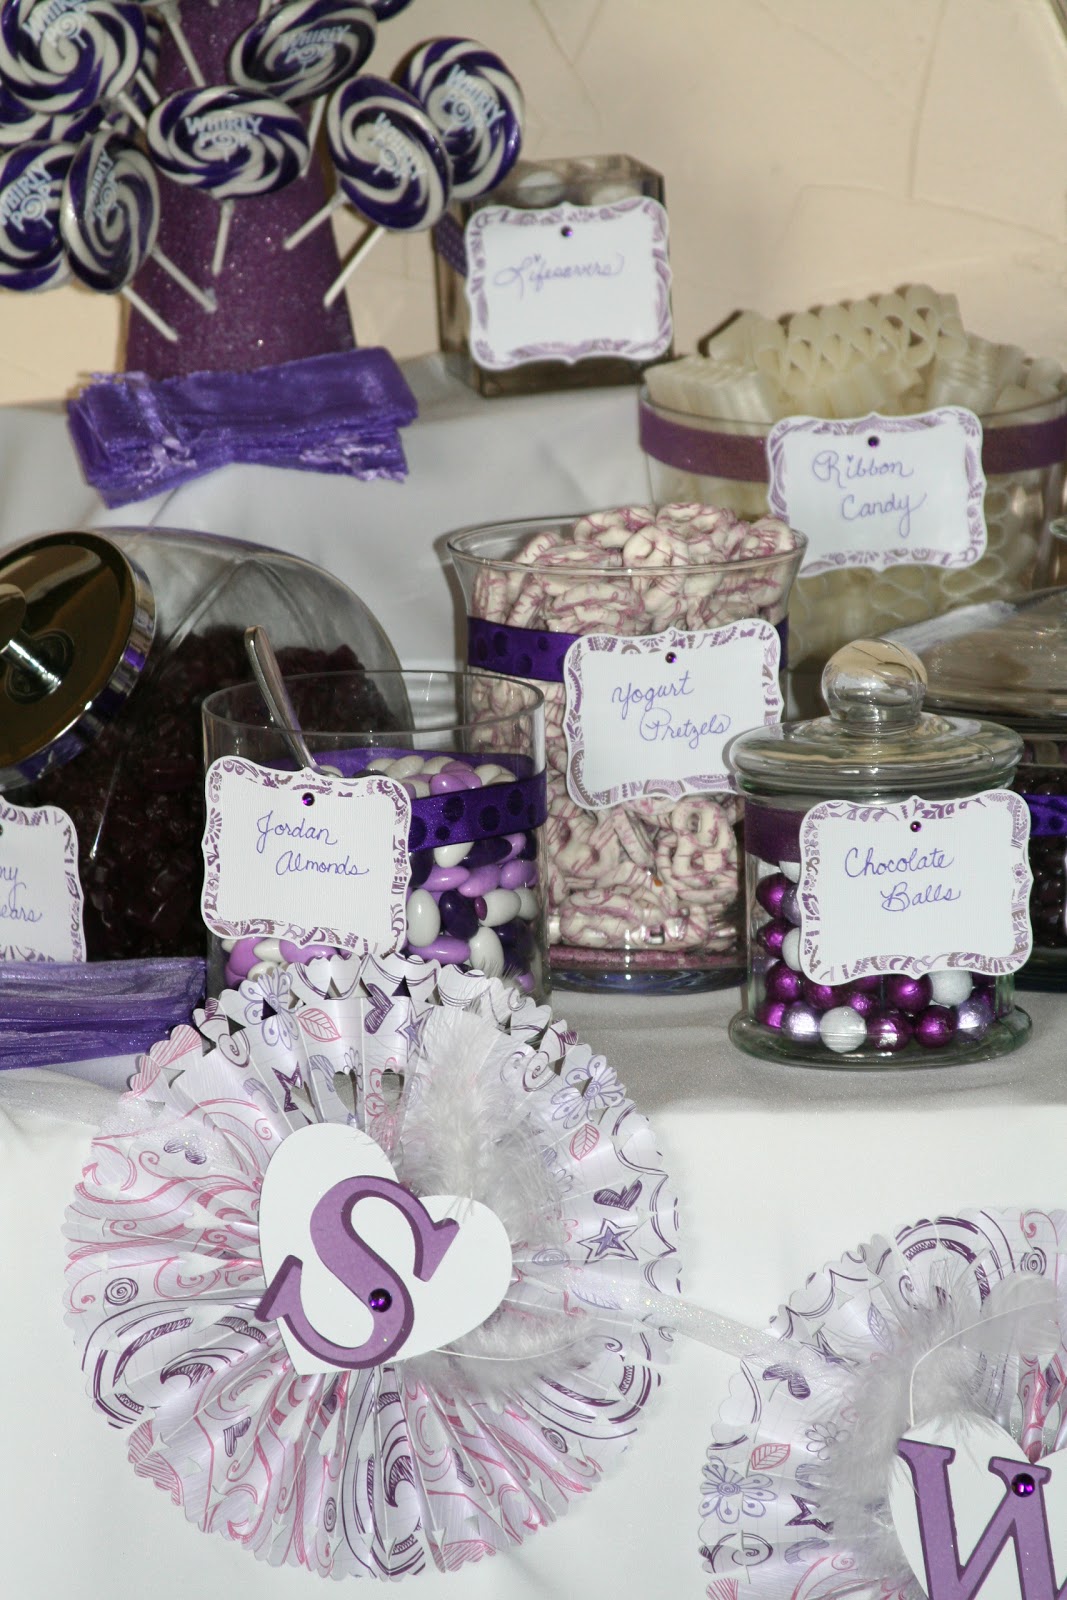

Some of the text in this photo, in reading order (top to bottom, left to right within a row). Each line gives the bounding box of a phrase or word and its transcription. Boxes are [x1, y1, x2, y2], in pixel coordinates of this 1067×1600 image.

[812, 450, 914, 488] Ribbon
[841, 492, 927, 538] Candy
[611, 670, 695, 720] Yogurt
[639, 706, 731, 749] Pretzels
[256, 810, 338, 854] Jordan
[276, 850, 370, 876] Almonds
[844, 847, 955, 878] Chocolate
[880, 881, 962, 912] Balls
[254, 1175, 460, 1370] S
[897, 1438, 1067, 1600] W
